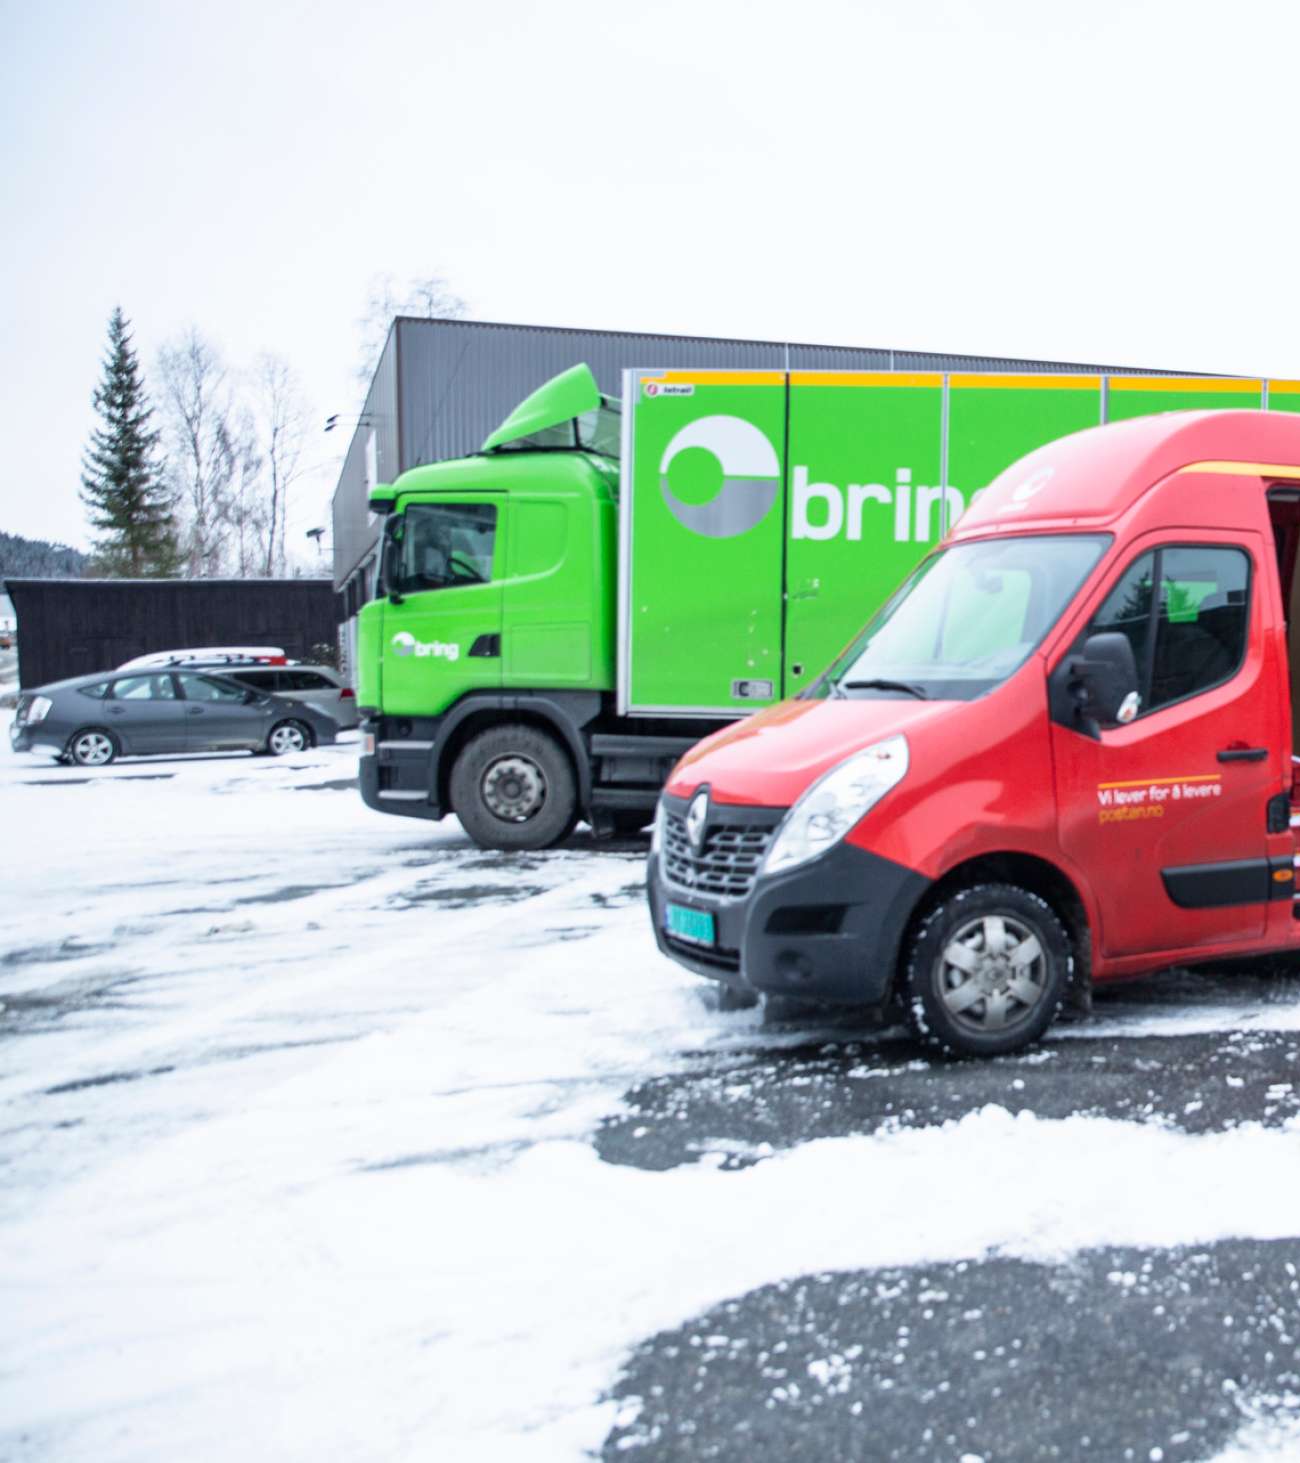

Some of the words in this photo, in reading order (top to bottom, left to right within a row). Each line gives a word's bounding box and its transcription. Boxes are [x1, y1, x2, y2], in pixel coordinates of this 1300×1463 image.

[792, 465, 986, 542] brin
[415, 640, 459, 662] bring
[1098, 790, 1112, 805] Vi
[1114, 789, 1147, 804] lever
[1149, 785, 1170, 801] for
[1183, 784, 1221, 798] levere
[1098, 804, 1163, 826] posten.no
